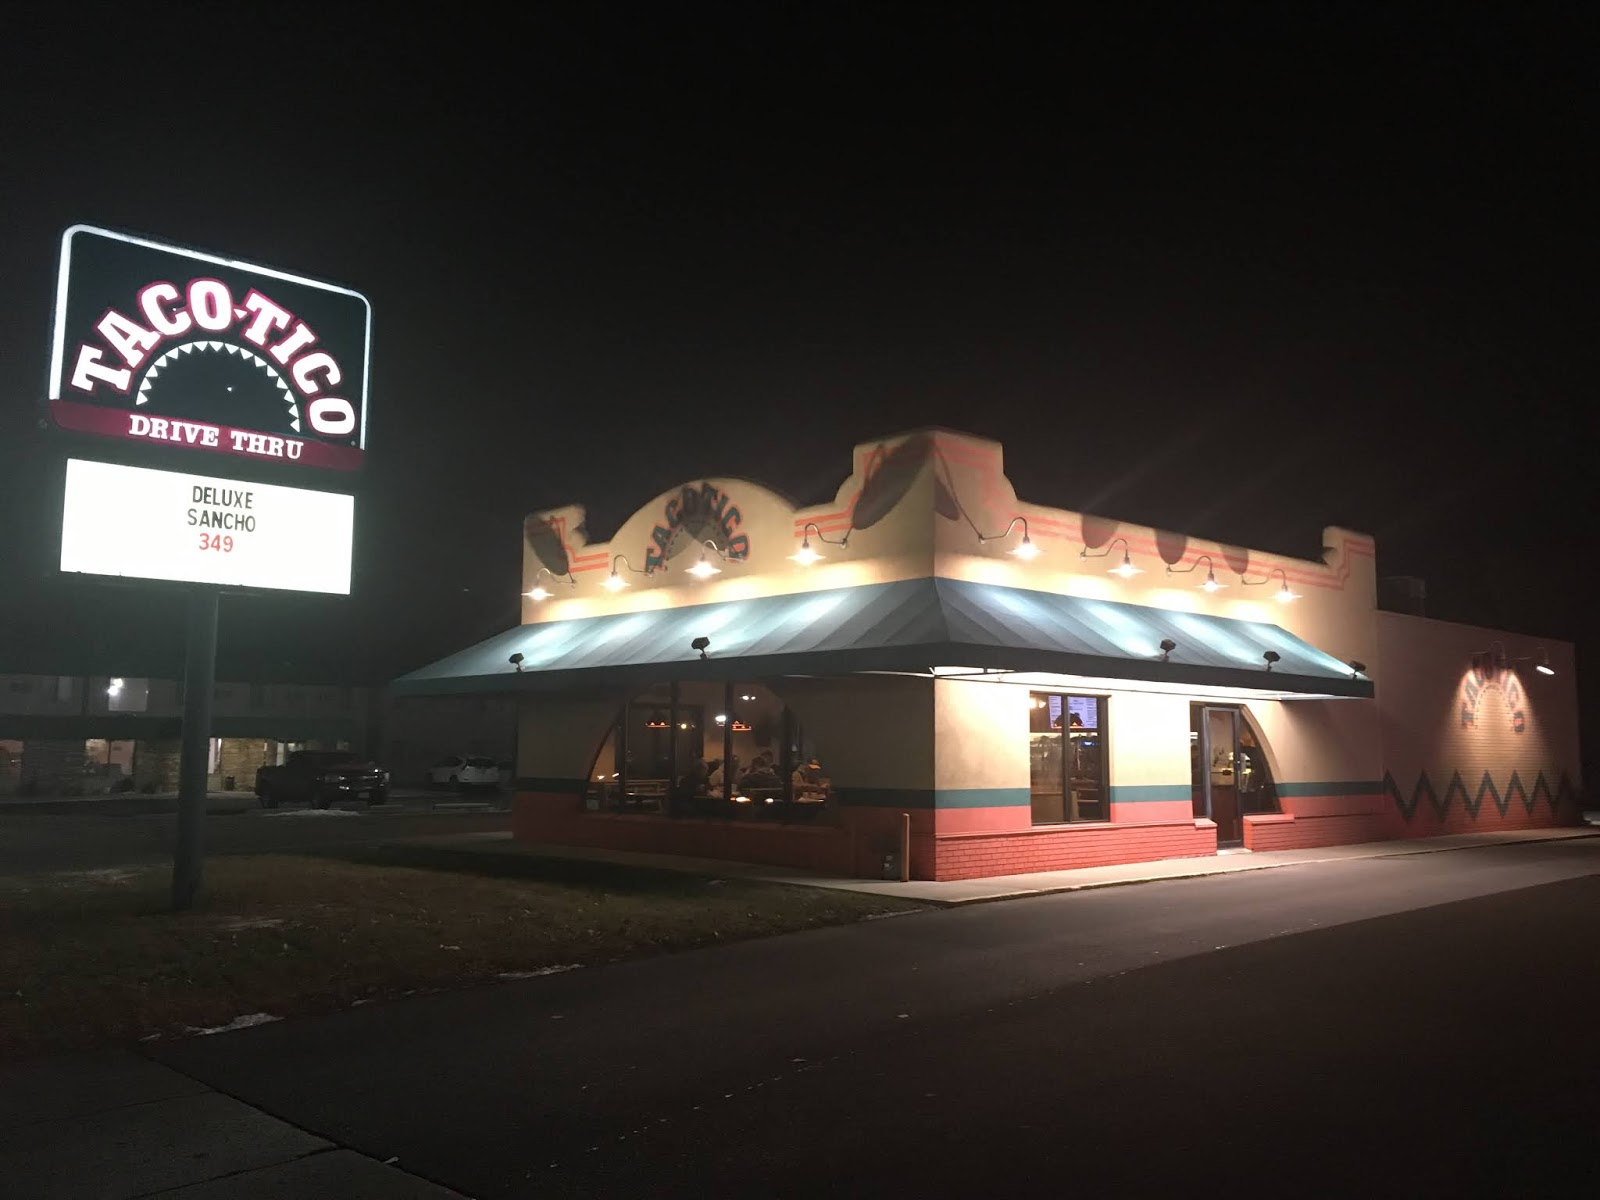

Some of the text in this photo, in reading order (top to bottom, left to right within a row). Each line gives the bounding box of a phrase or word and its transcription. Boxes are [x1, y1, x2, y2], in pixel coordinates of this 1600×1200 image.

[129, 414, 304, 459] DRIVE THRU
[192, 485, 254, 509] DELUXE
[187, 508, 255, 533] SANCHO
[198, 533, 234, 553] 349
